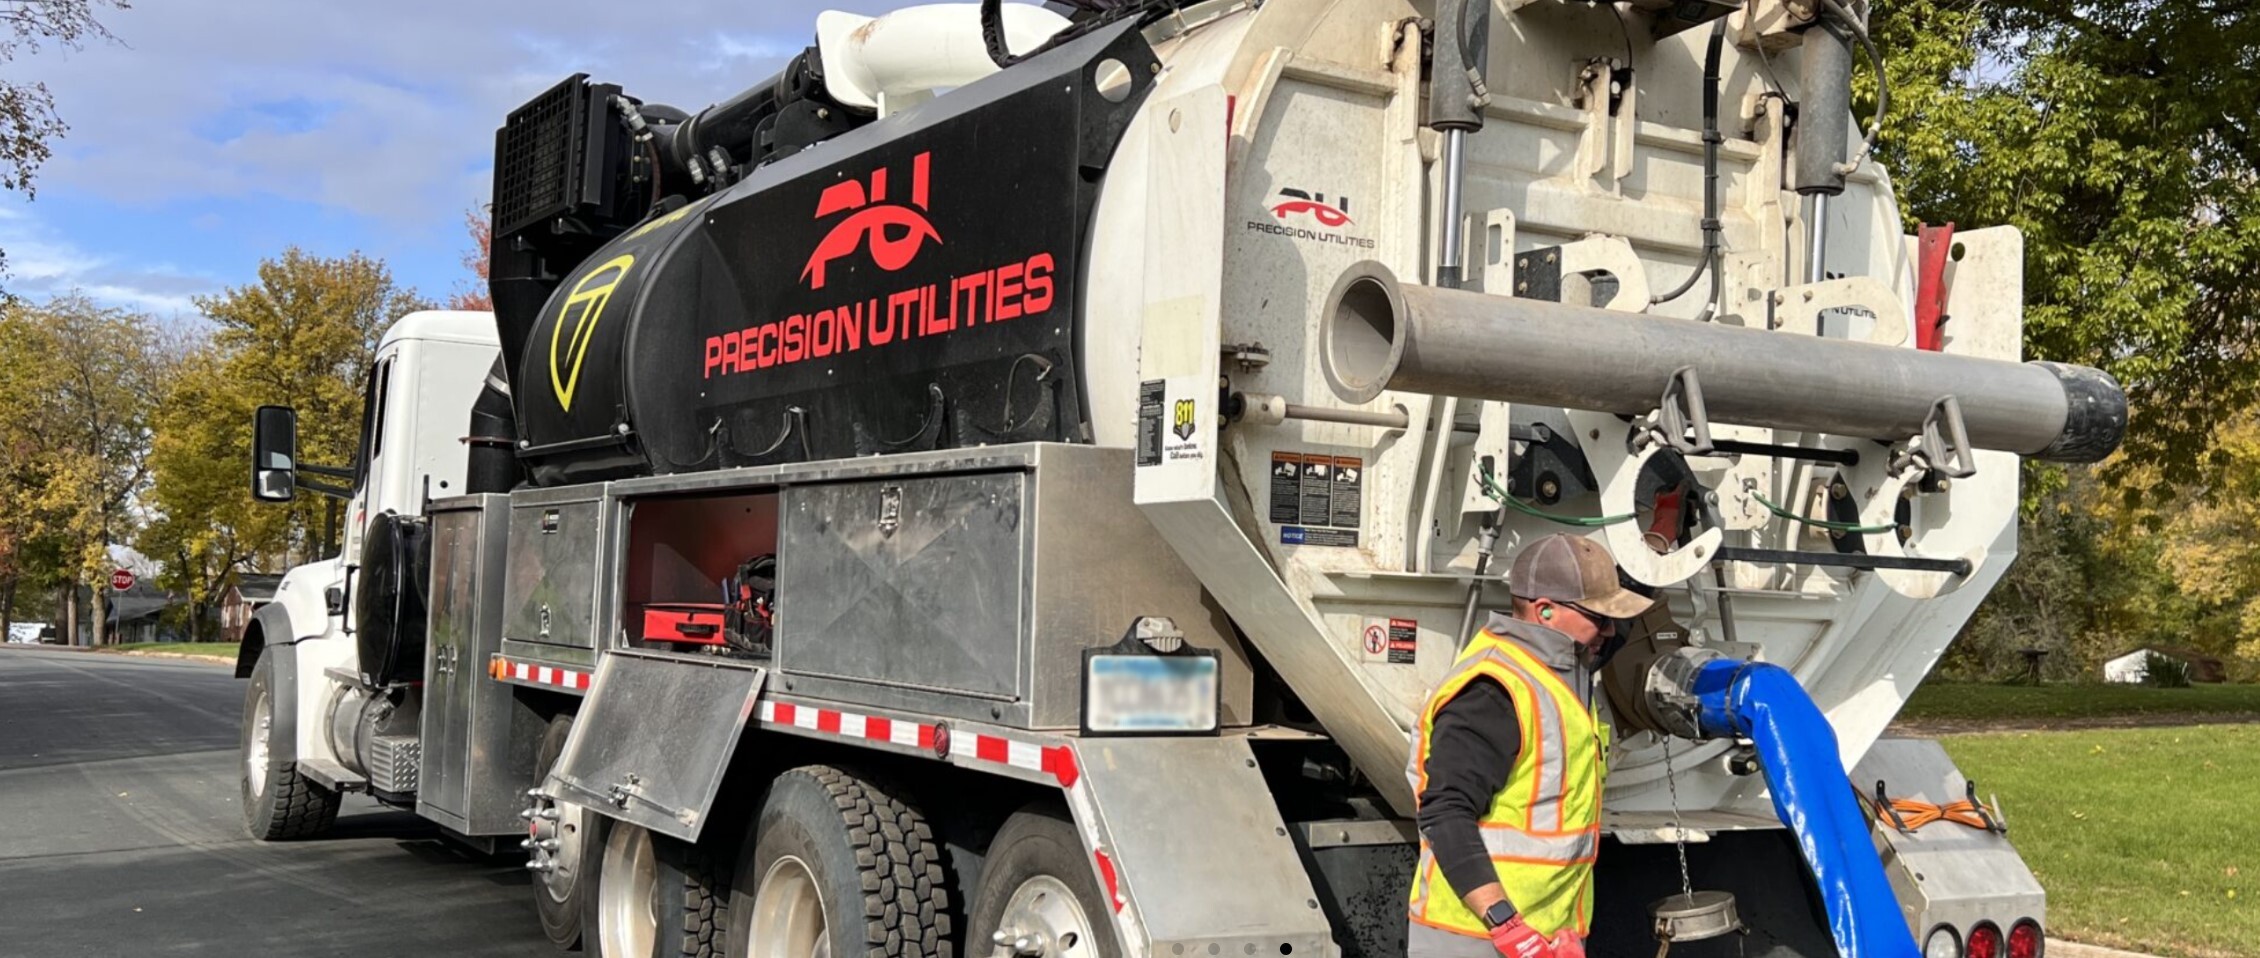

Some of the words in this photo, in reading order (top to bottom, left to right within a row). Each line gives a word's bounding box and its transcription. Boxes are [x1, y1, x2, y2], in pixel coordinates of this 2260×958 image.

[1247, 221, 1317, 241] PRECISION
[1318, 231, 1375, 249] UTILITIES
[704, 302, 862, 379] PRECISION
[868, 252, 1055, 346] UTILITIES
[1175, 399, 1195, 427] 811
[112, 575, 132, 584] STOP
